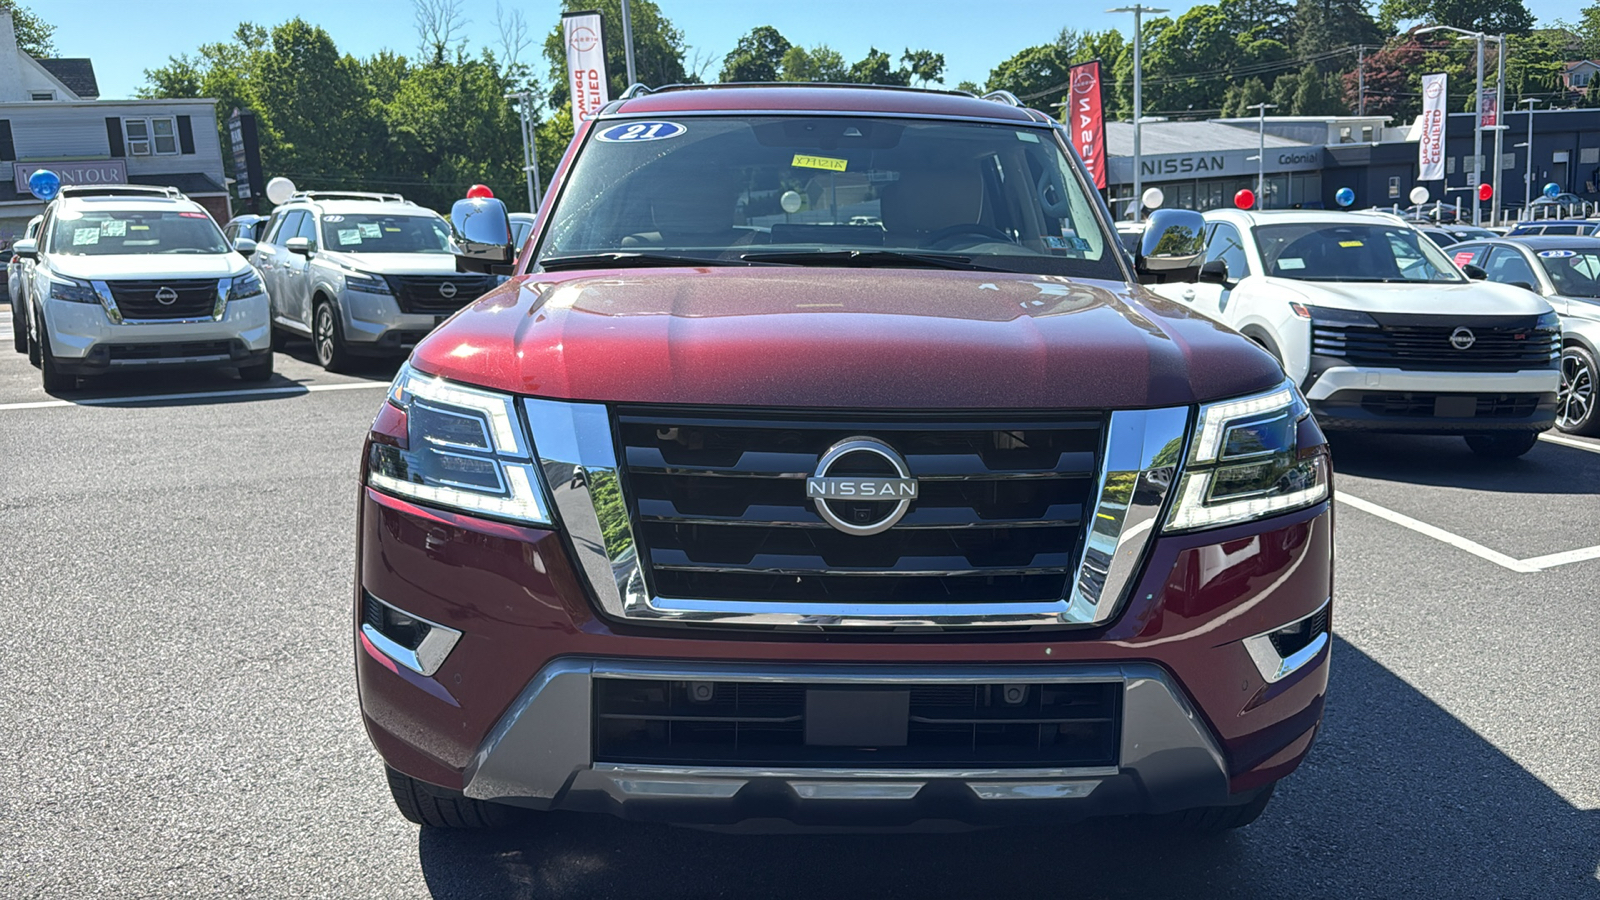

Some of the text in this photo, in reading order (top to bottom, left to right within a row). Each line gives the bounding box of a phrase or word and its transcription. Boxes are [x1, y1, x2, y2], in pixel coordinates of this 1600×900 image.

[618, 123, 664, 140] 21
[1141, 156, 1224, 176] NISSAN
[1278, 152, 1318, 165] Colonial
[54, 168, 120, 183] NTOUR
[809, 481, 915, 496] NISSAN
